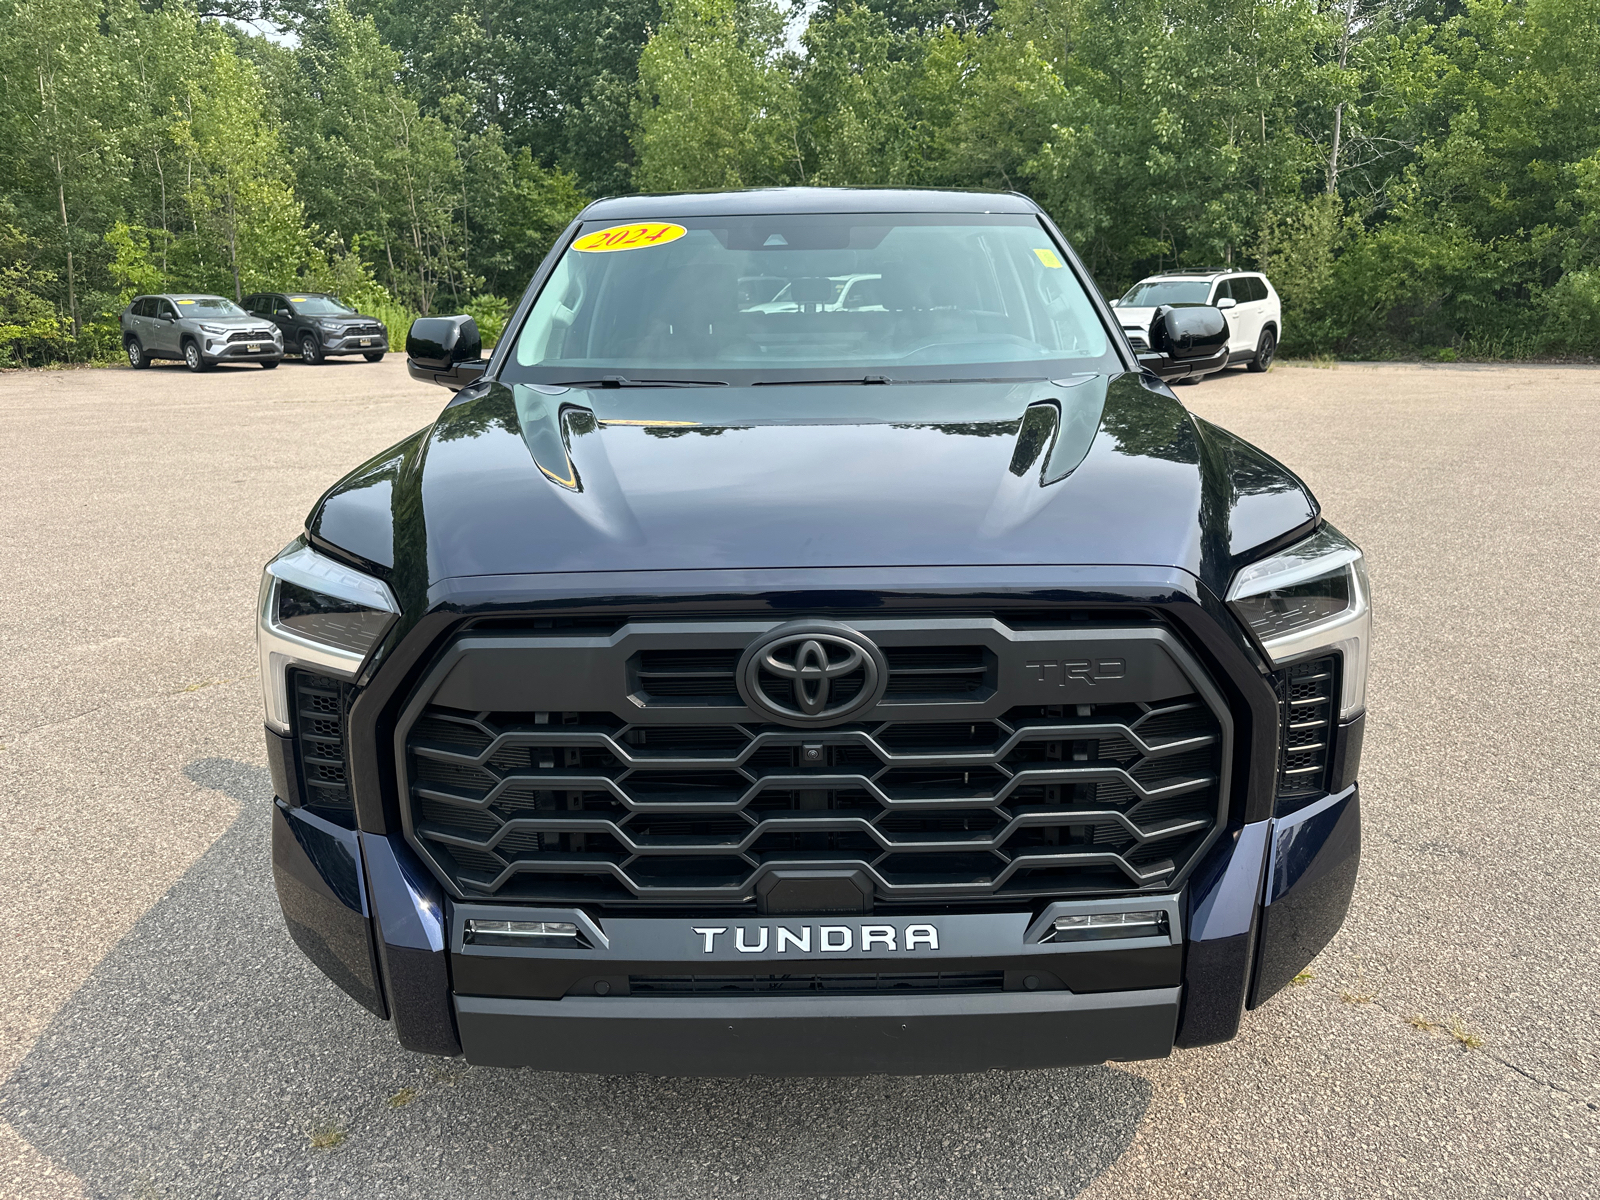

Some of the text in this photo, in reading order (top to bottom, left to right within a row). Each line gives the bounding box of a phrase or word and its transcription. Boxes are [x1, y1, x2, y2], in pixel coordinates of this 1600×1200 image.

[585, 226, 672, 250] 2024
[1025, 658, 1126, 687] TRD
[691, 924, 940, 953] TUNDRA
